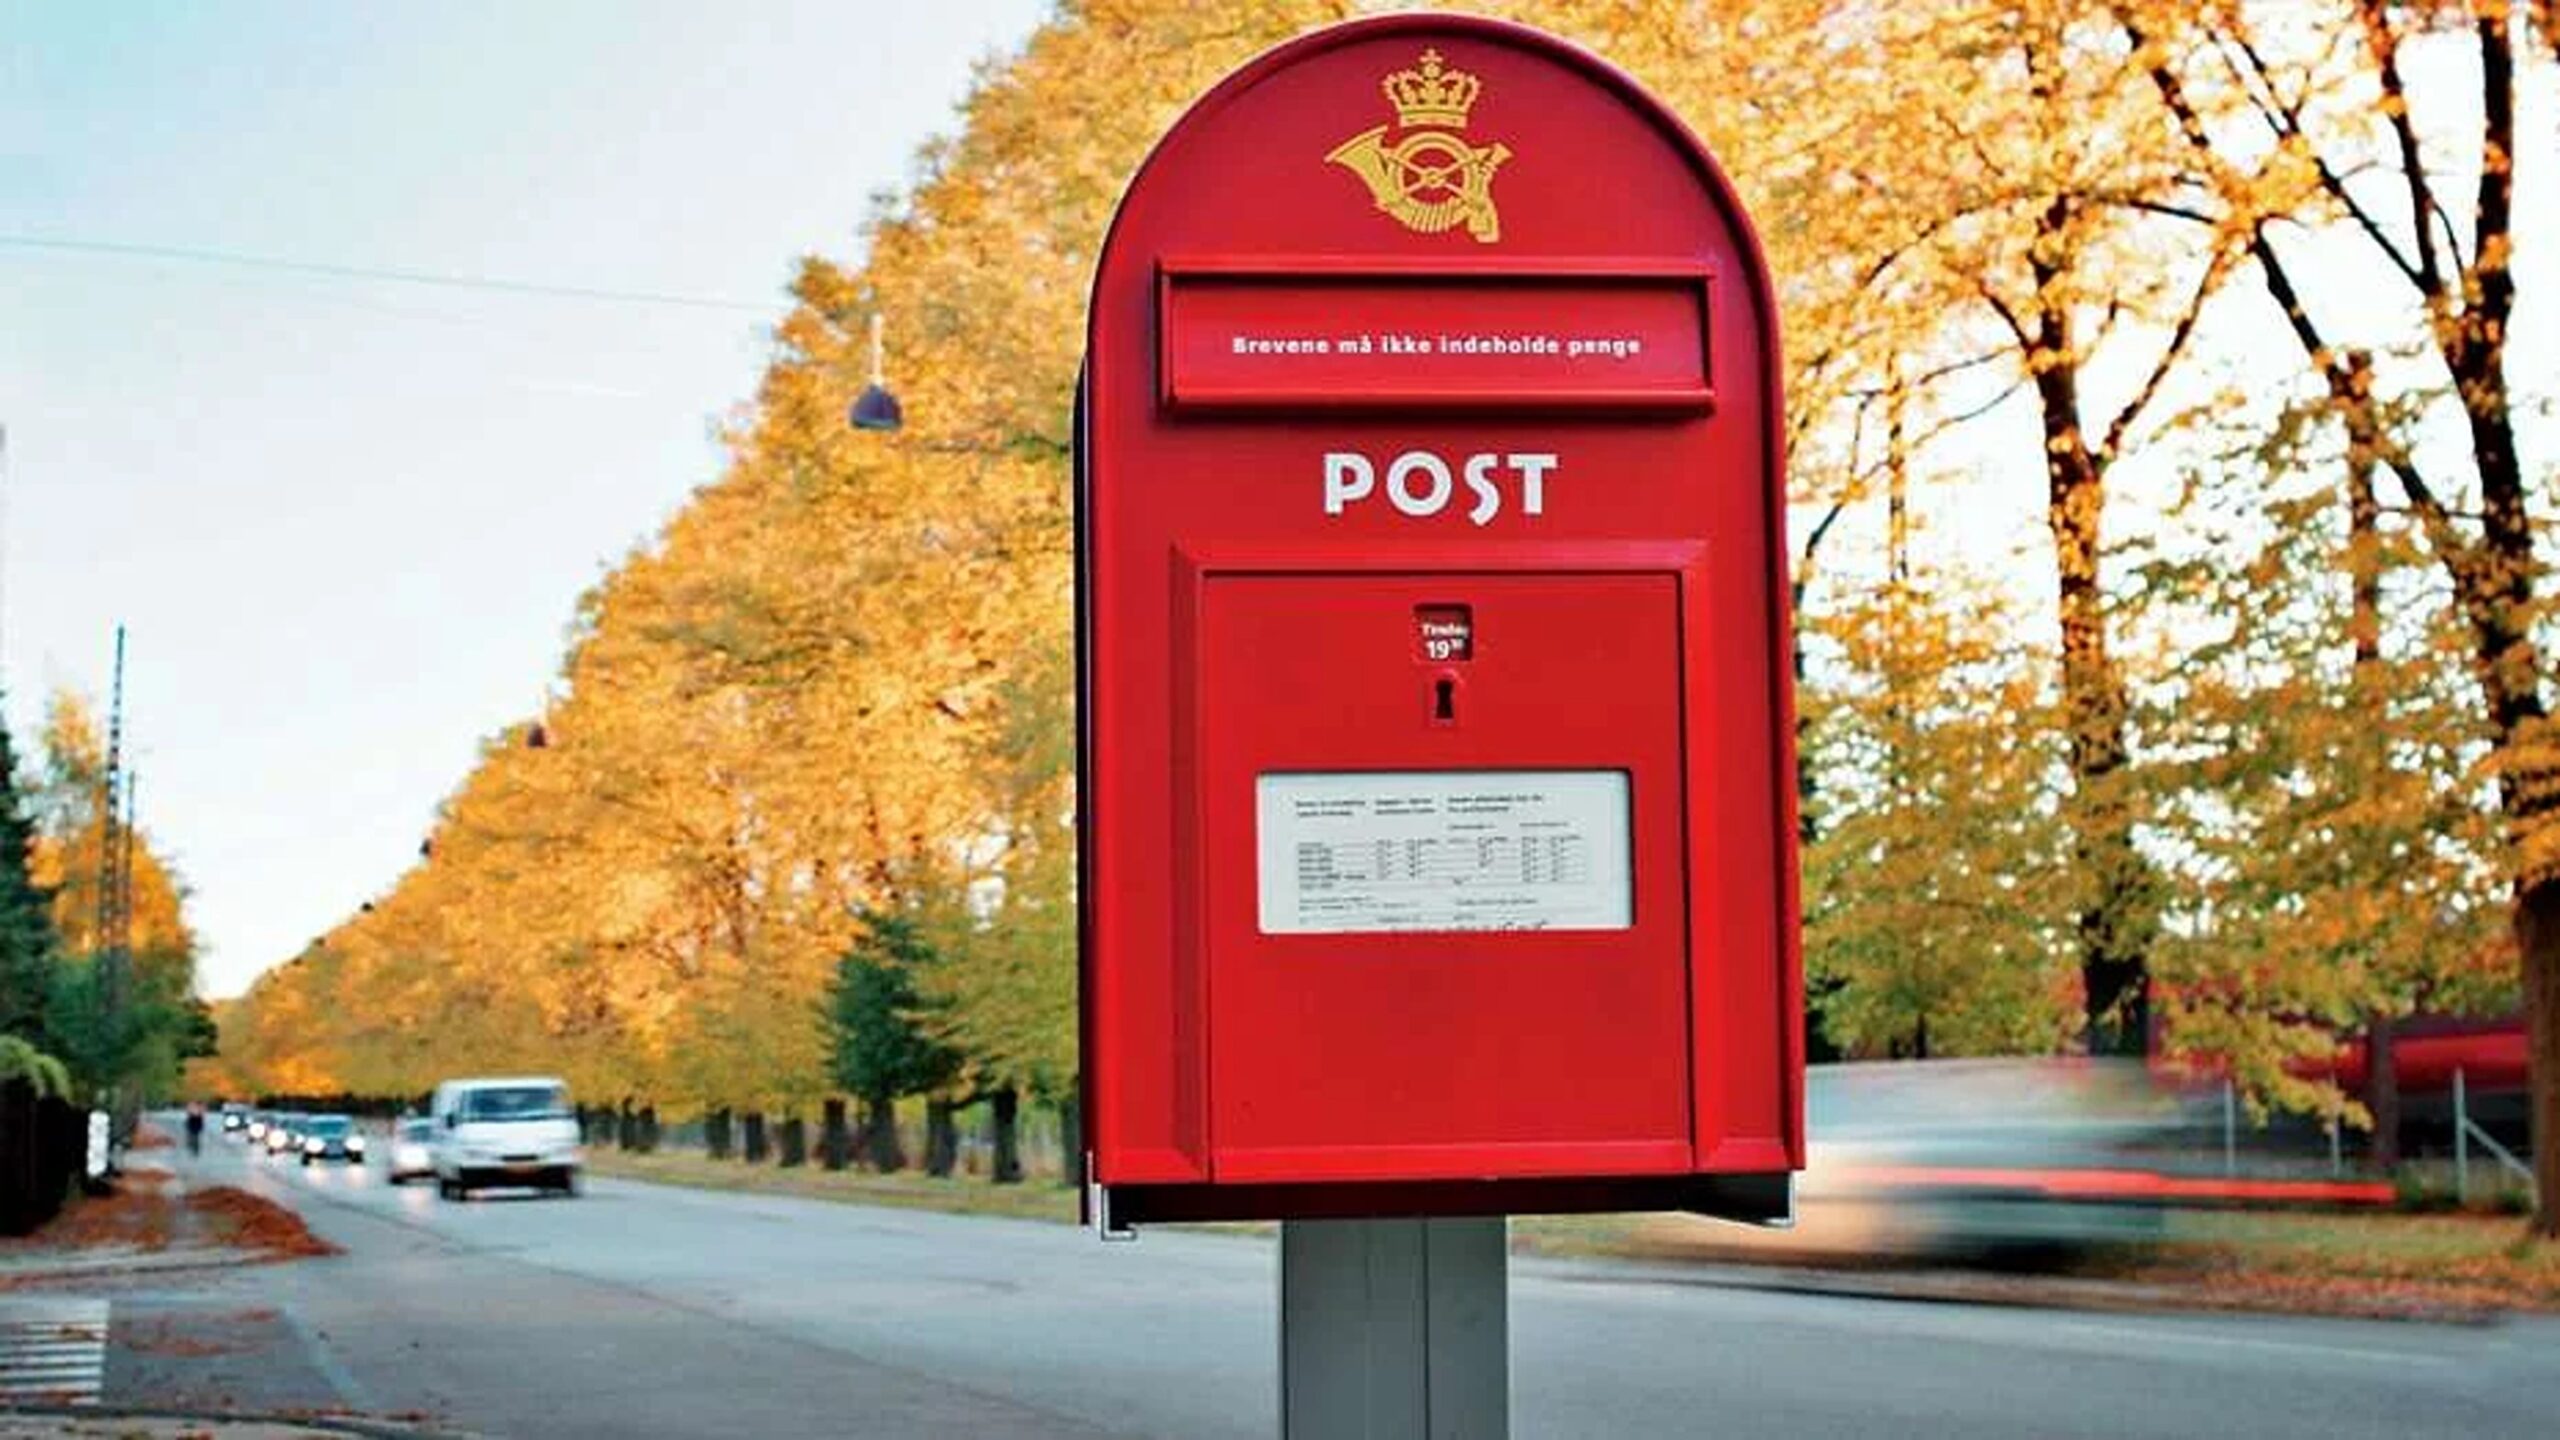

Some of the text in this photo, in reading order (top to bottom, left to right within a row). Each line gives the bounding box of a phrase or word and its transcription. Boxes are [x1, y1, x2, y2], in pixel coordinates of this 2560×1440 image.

[1232, 334, 1642, 360] Brevene må ikke indeholde penge
[1323, 450, 1559, 527] POST
